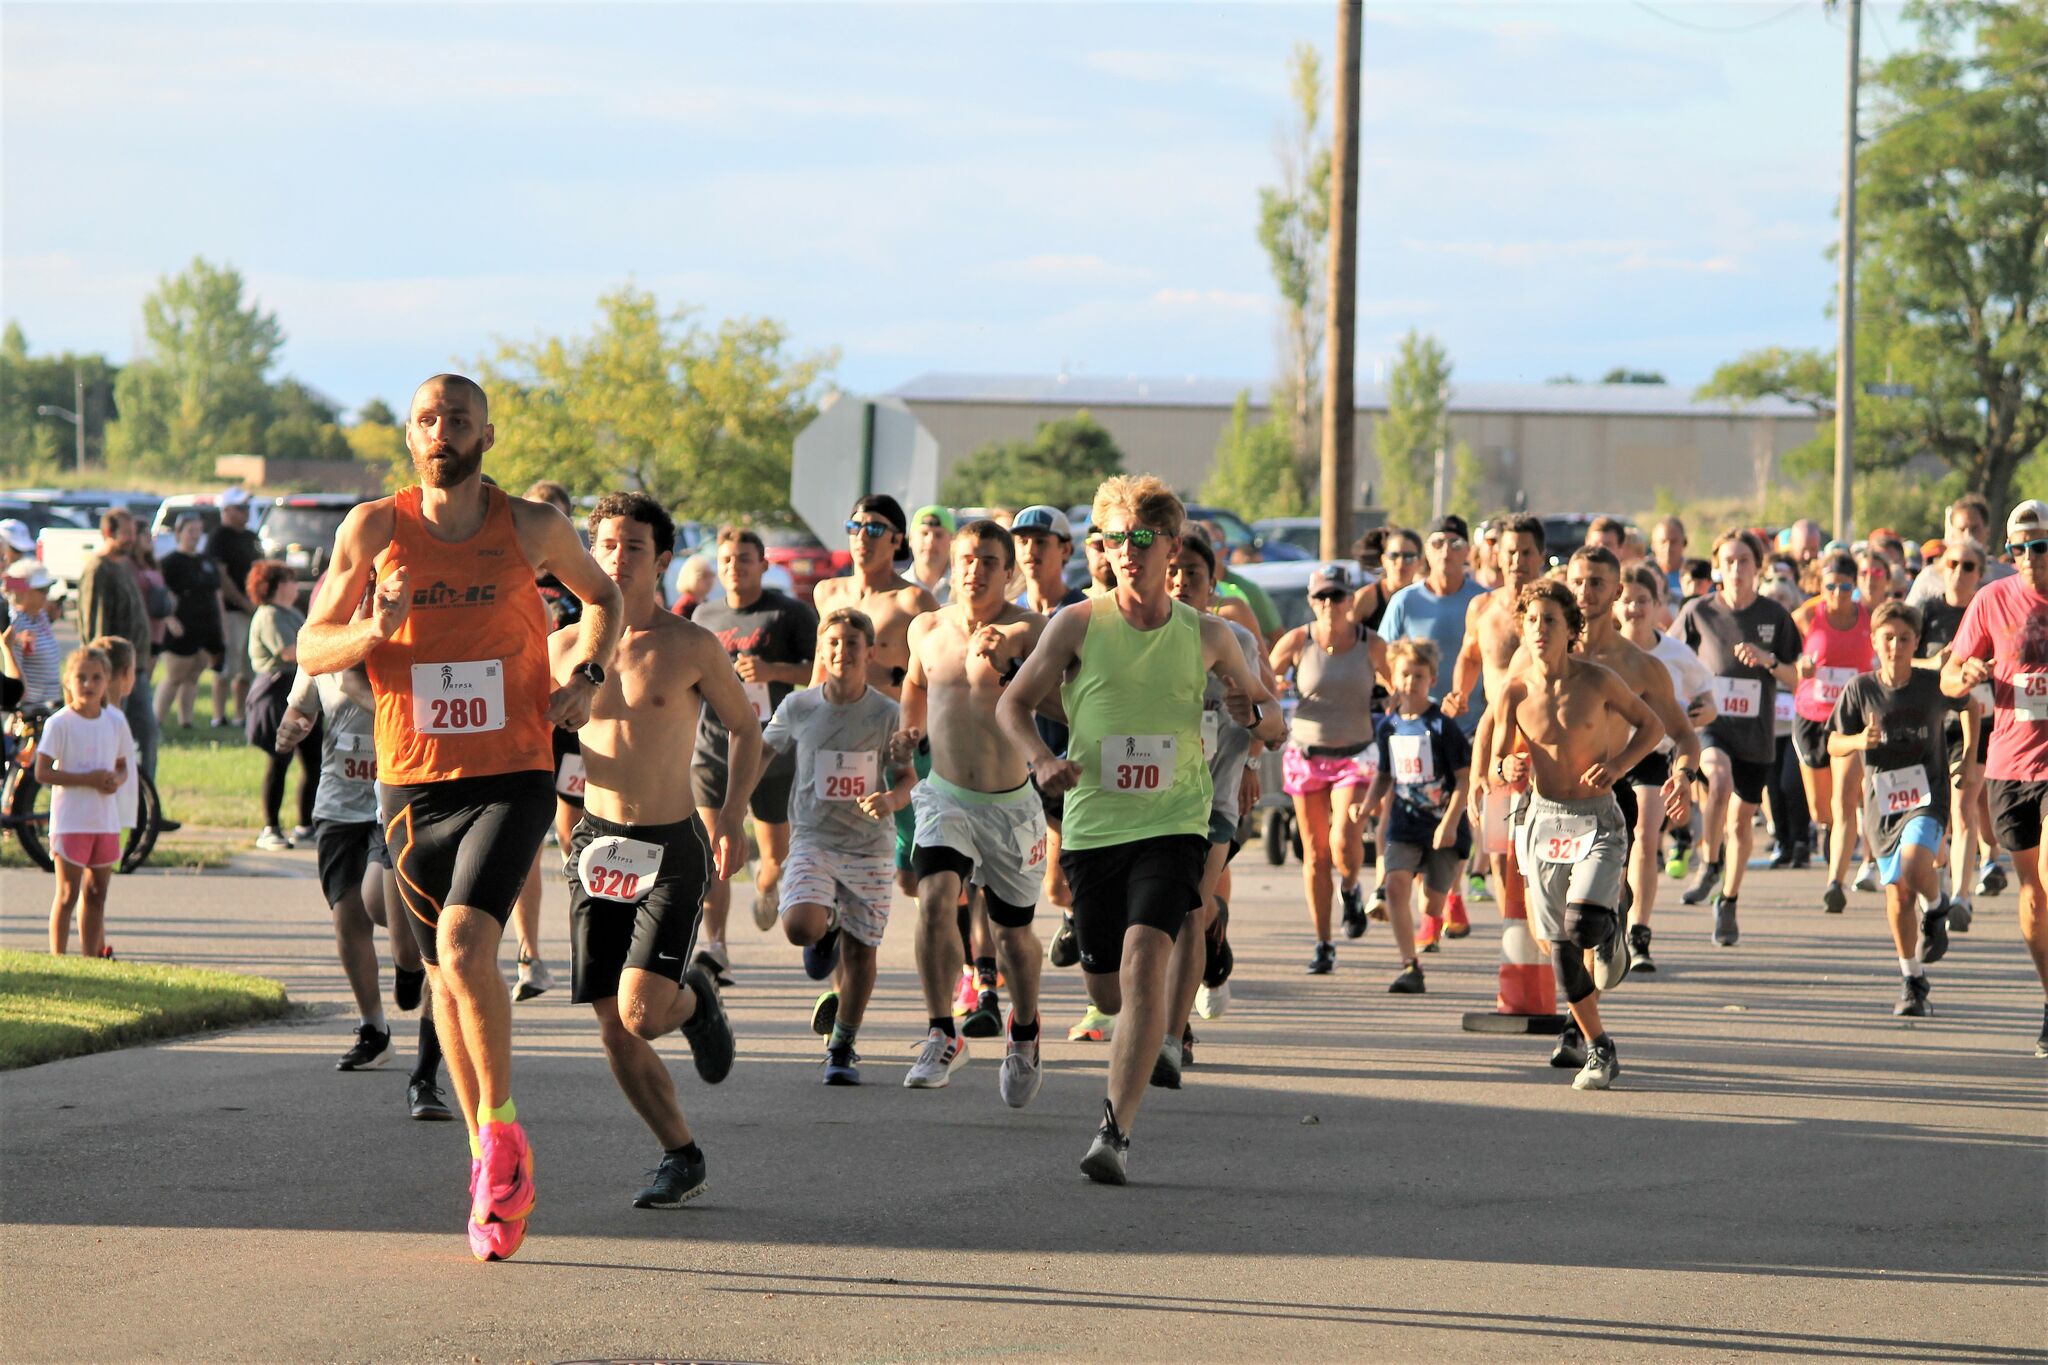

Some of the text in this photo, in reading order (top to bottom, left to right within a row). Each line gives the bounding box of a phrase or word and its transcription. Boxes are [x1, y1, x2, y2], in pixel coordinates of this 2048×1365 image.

[1823, 685, 1845, 698] 20
[431, 697, 487, 728] 280
[1723, 697, 1749, 713] 149
[826, 776, 865, 797] 295
[1117, 764, 1159, 789] 370
[1888, 788, 1921, 811] 294
[1548, 838, 1581, 859] 321
[589, 866, 640, 900] 320
